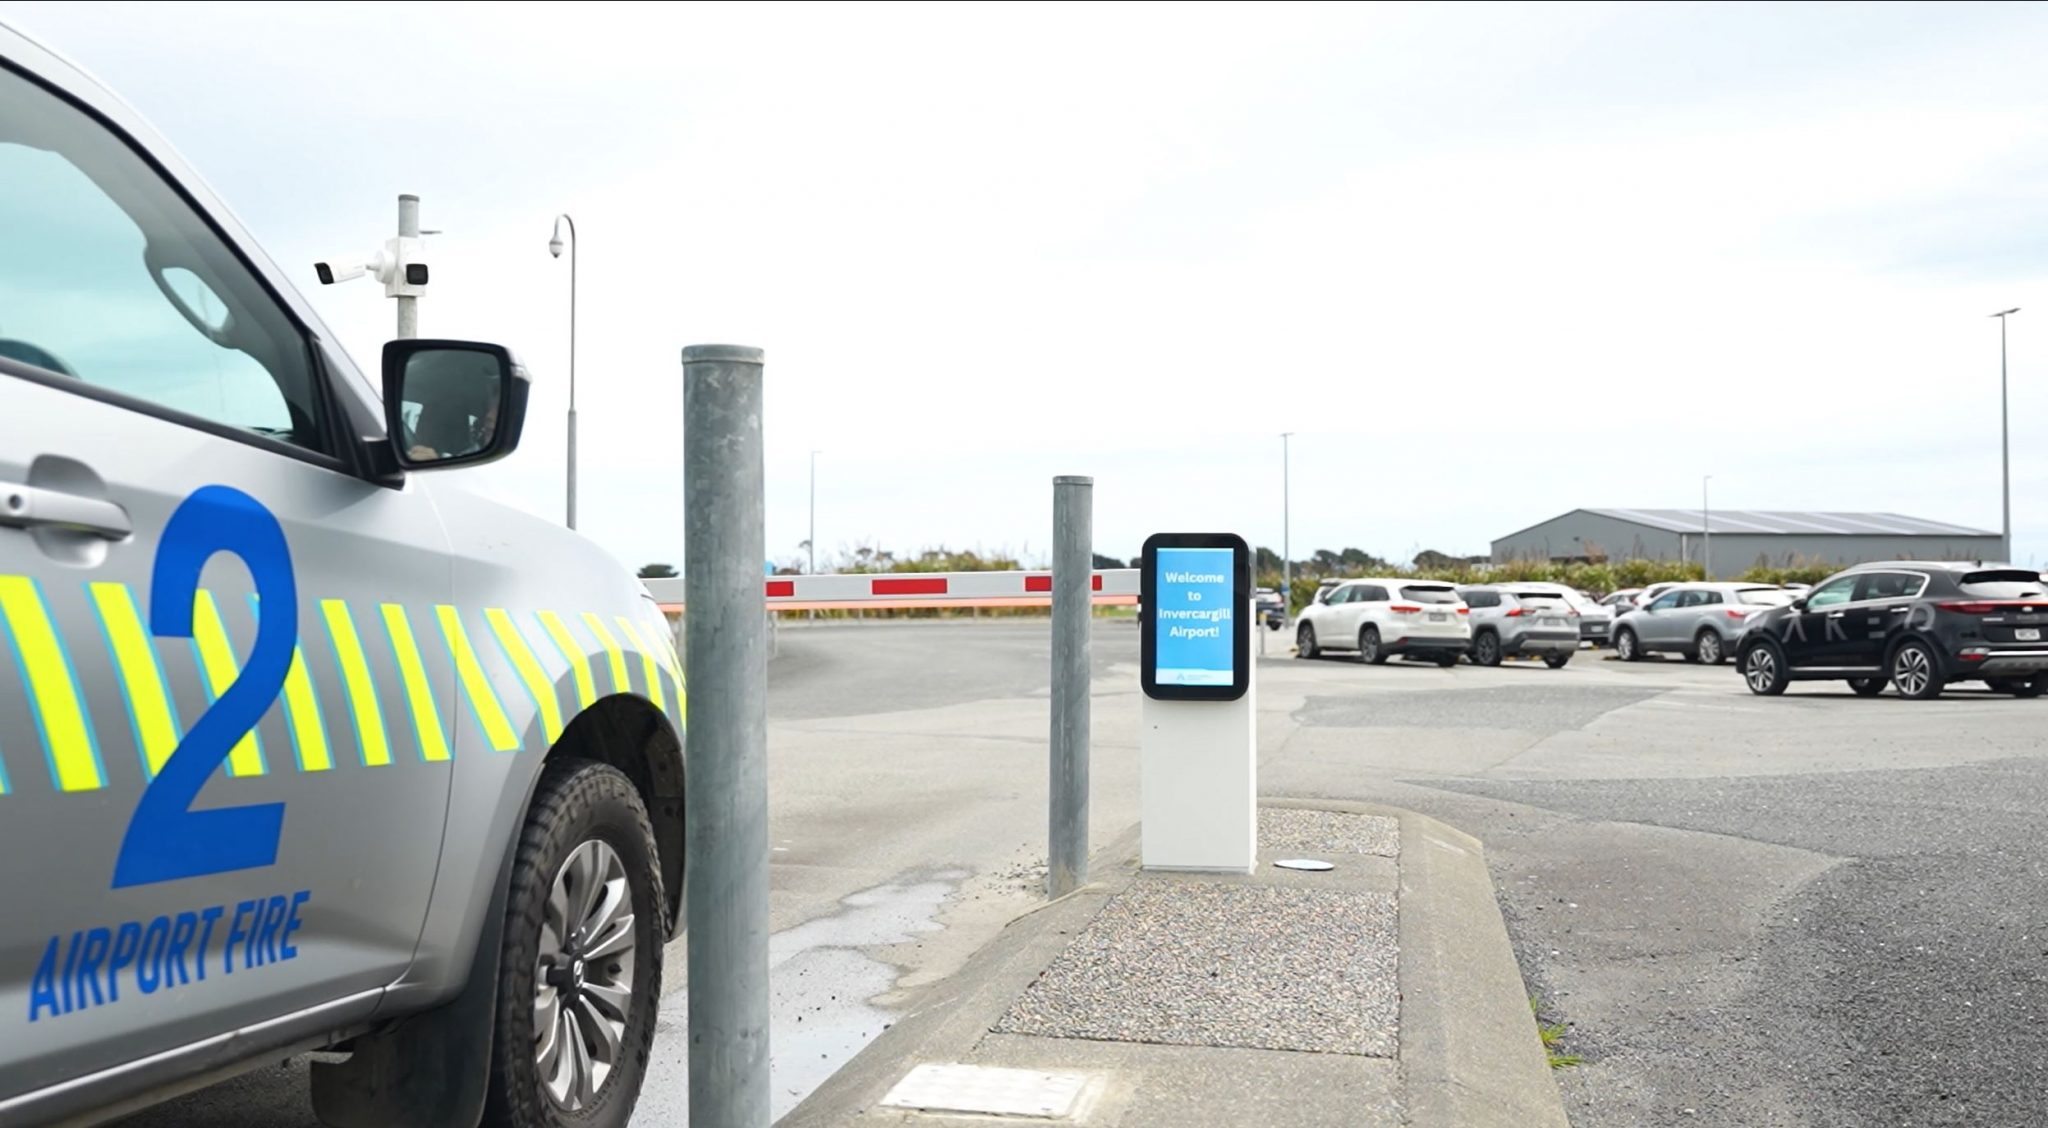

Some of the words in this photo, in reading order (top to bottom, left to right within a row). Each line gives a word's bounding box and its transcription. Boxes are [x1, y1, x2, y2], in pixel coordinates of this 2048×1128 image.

[1165, 572, 1225, 584] Welcome
[1187, 591, 1202, 602] to
[1159, 608, 1231, 622] Invercargill
[1169, 626, 1220, 640] Airport!
[110, 484, 298, 889] 2
[28, 906, 224, 1023] AIRPORT
[225, 890, 311, 974] FIRE
